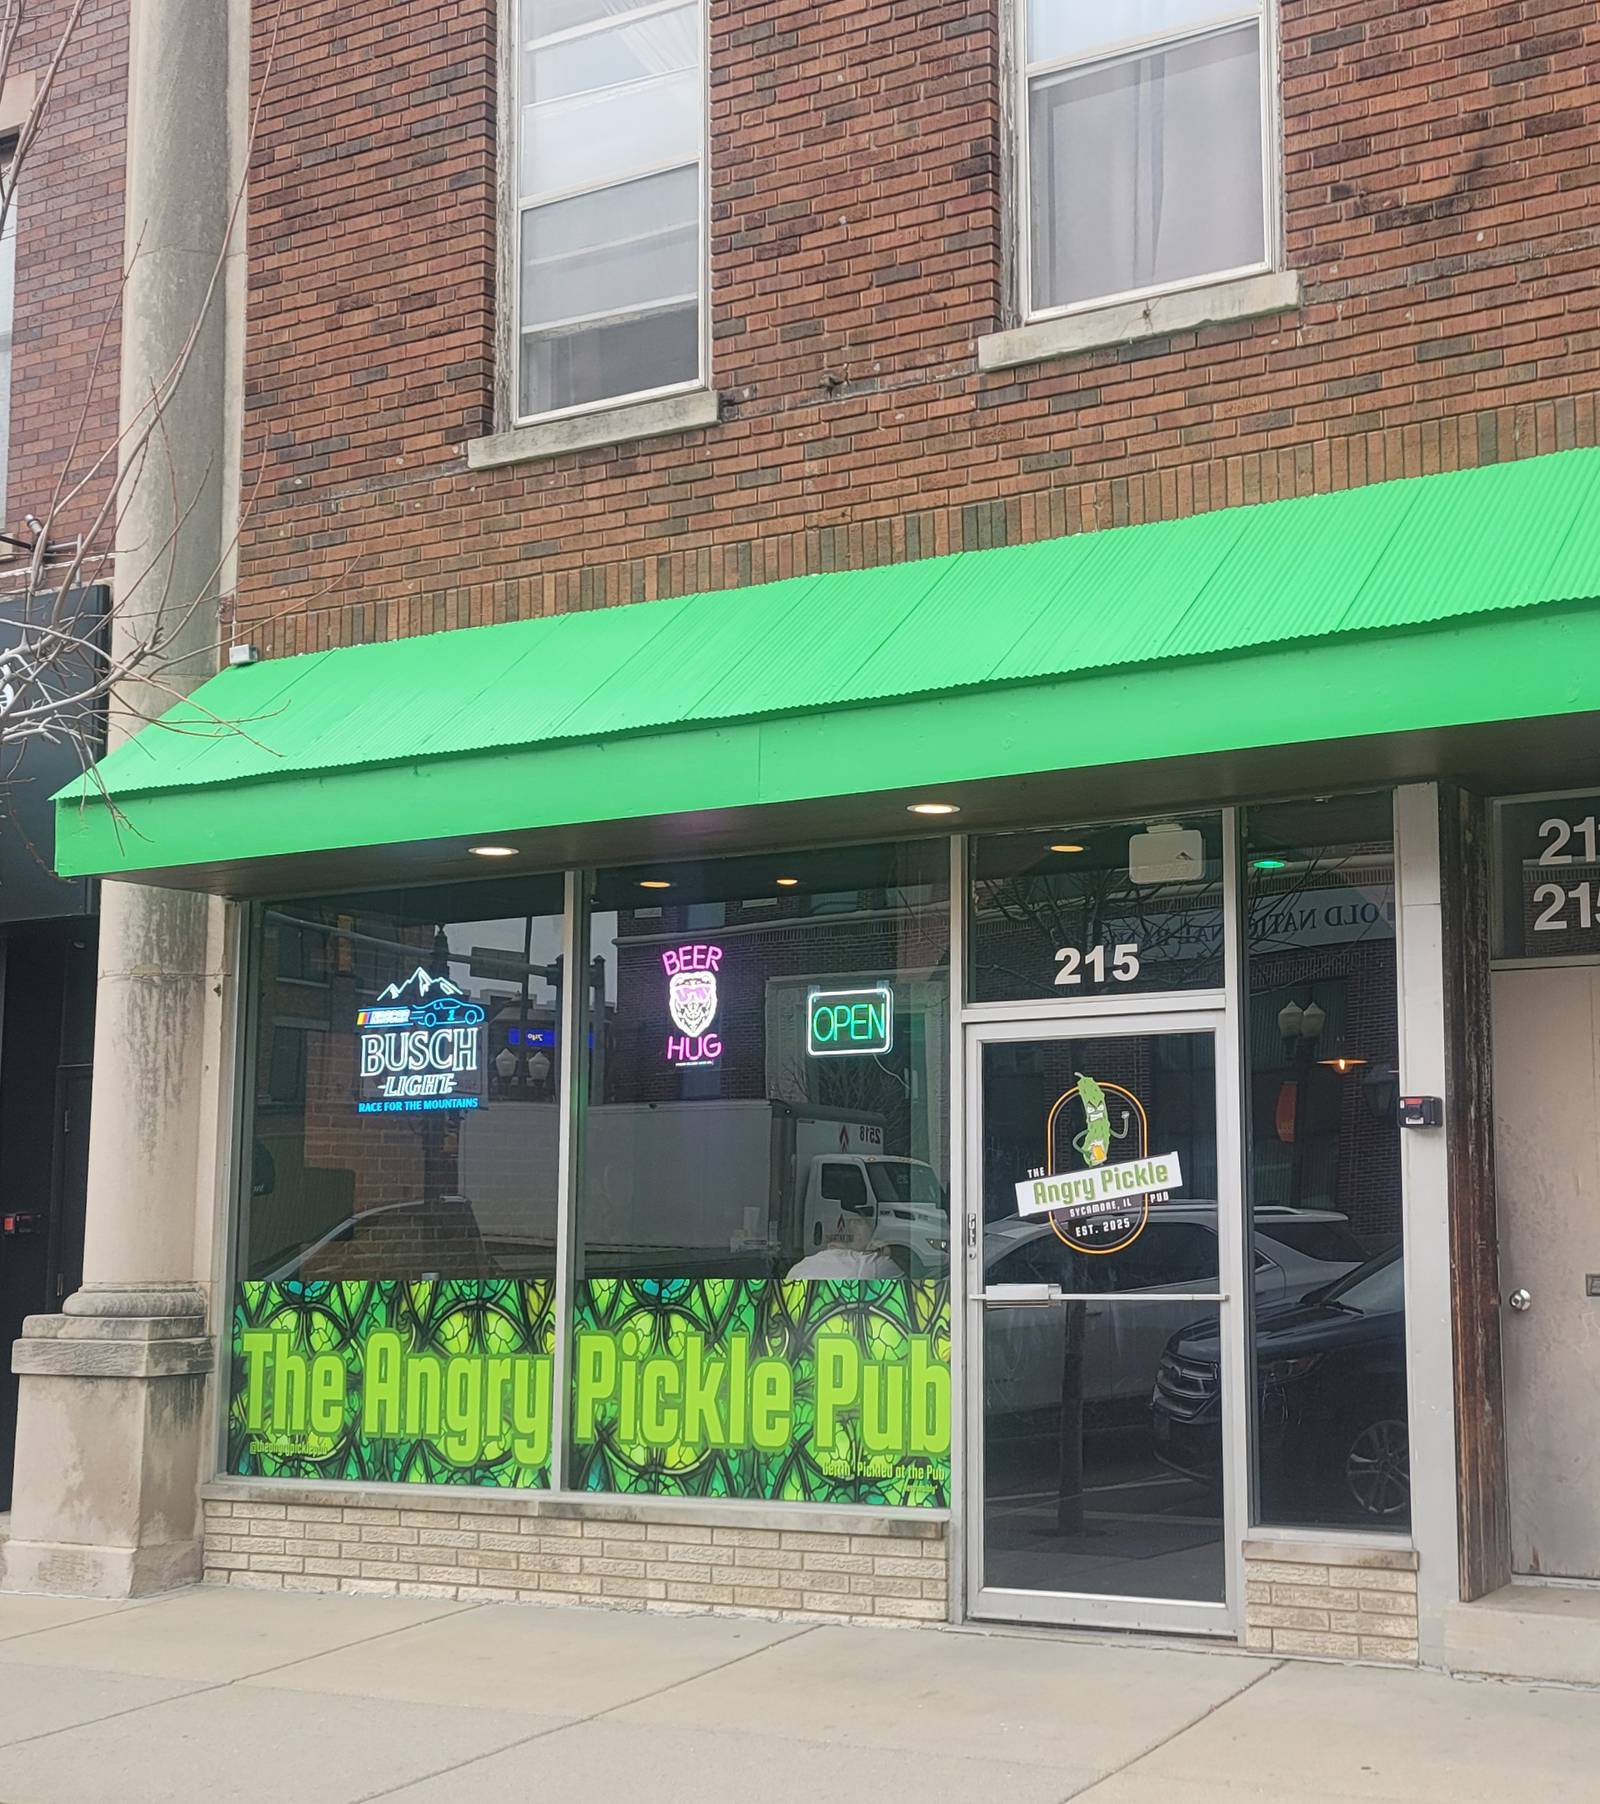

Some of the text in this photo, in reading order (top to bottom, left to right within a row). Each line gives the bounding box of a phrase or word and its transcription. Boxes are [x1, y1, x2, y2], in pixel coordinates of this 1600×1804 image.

[1538, 816, 1600, 865] 21
[662, 945, 723, 976] BEER
[1054, 943, 1140, 985] 215
[813, 1003, 885, 1042] OPEN
[360, 1027, 480, 1077] BUSCH
[666, 1033, 722, 1061] HUG
[383, 1073, 454, 1097] LIGHT
[358, 1097, 479, 1113] RACE FOR THE MOUNTAINS
[1027, 1166, 1045, 1179] THE
[1033, 1162, 1168, 1206] Angry Pickle
[1123, 1198, 1132, 1208] IL
[1149, 1191, 1169, 1204] PUB
[968, 1213, 976, 1247] PULL
[1075, 1218, 1131, 1238] EST. 2025
[242, 1328, 951, 1468] The Angry Pickle Pub
[857, 1461, 893, 1478] Pickled
[895, 1464, 905, 1479] at
[908, 1464, 924, 1480] the
[926, 1465, 945, 1481] Pub
